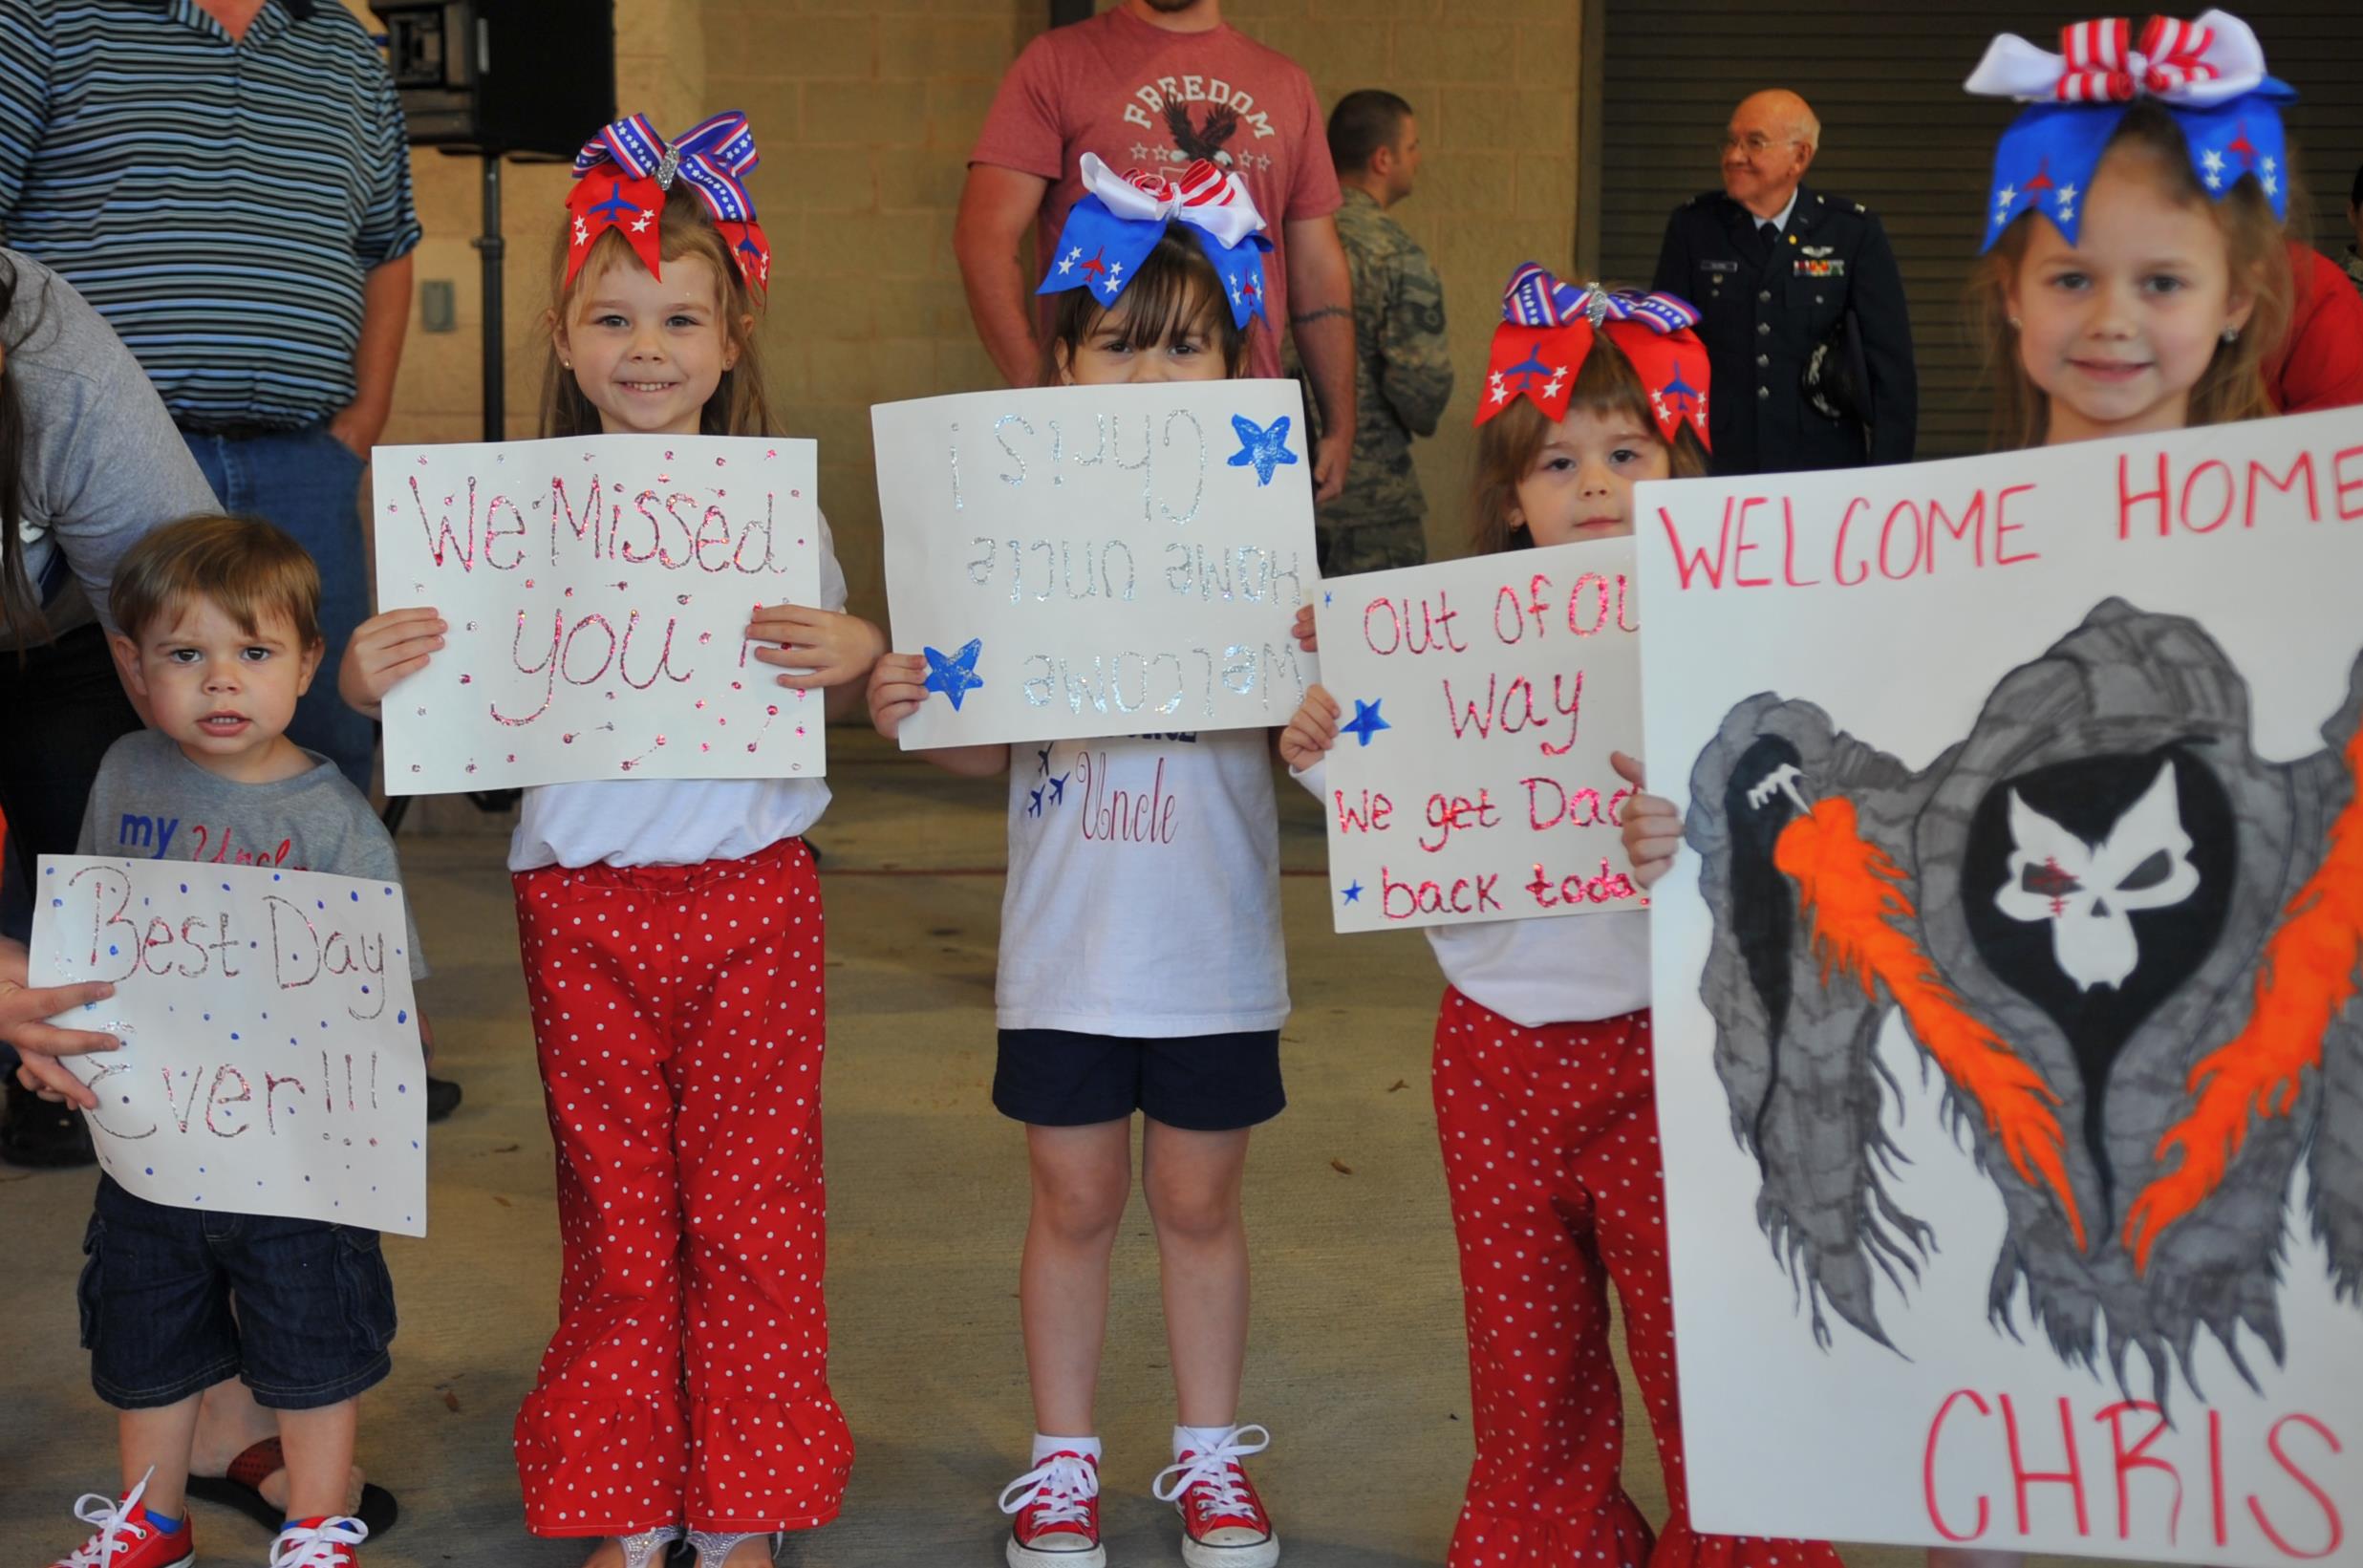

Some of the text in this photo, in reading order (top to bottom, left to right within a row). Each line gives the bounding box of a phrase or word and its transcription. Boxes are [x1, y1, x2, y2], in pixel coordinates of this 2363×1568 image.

[1124, 75, 1275, 140] FREEDOM
[409, 474, 787, 573] We Missed
[1657, 445, 2363, 591] WELCOME HOME
[490, 609, 695, 726] you
[119, 813, 309, 871] my Uncl
[1076, 751, 1178, 844] Uncle
[1335, 789, 1393, 834] We
[1418, 788, 1502, 852] get
[1382, 857, 1650, 919] back toda
[54, 866, 385, 1020] Best Day
[1923, 1388, 2343, 1559] CHRIS
